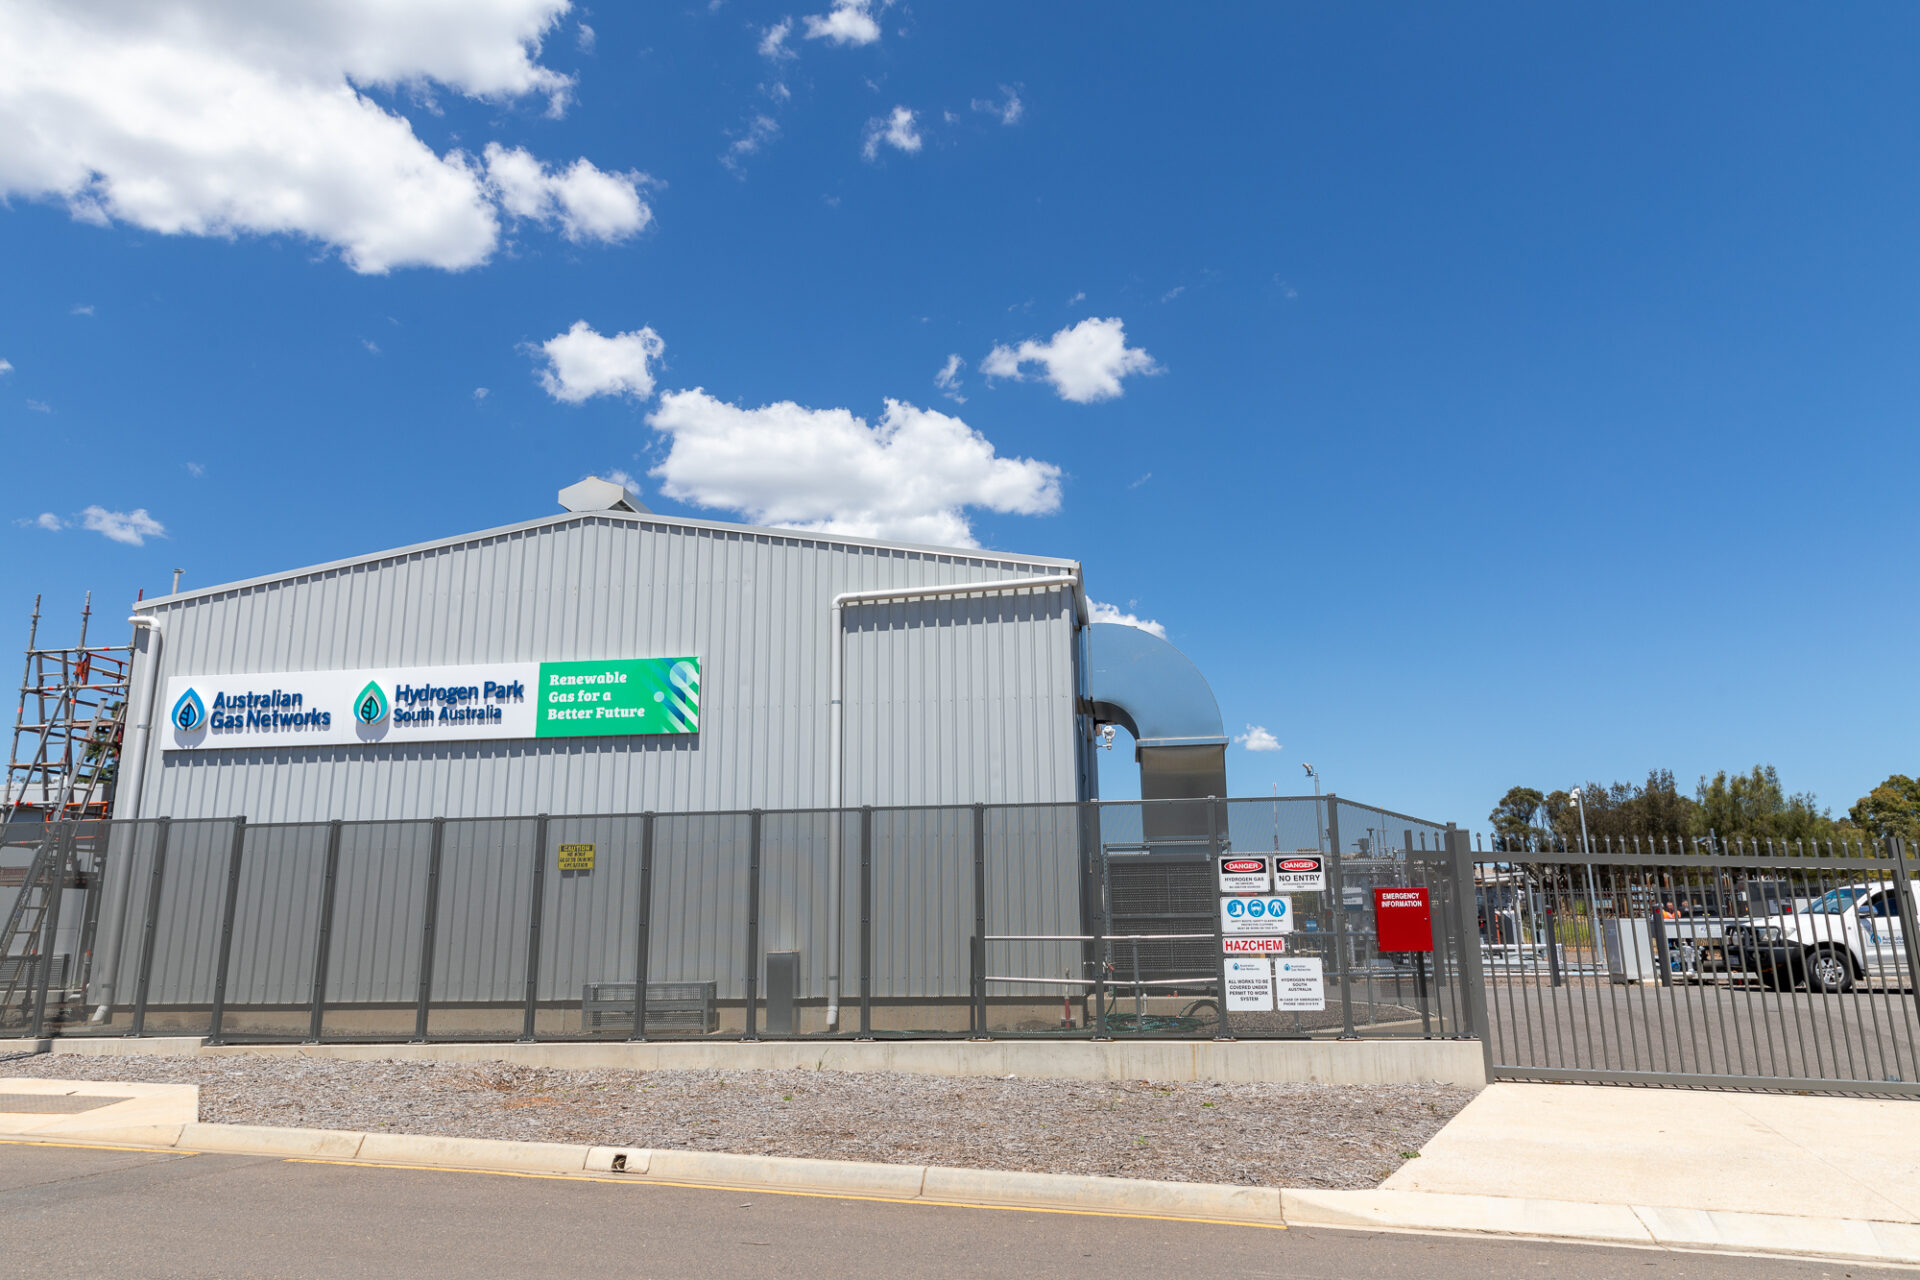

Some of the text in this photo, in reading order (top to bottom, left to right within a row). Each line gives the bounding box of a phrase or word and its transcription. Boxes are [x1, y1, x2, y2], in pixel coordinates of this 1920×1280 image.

[549, 671, 627, 686] Renewable
[213, 689, 303, 709] Australian
[395, 680, 524, 706] Hydrogen Park
[548, 690, 611, 703] Gas for a
[210, 707, 331, 729] Gas Networks
[393, 704, 502, 722] South Australia
[547, 707, 645, 720] Better Future
[1228, 862, 1259, 870] DANGER
[1283, 861, 1314, 869] DANGER
[1293, 874, 1320, 882] ENTRY
[1225, 940, 1283, 951] HAZCHEM
